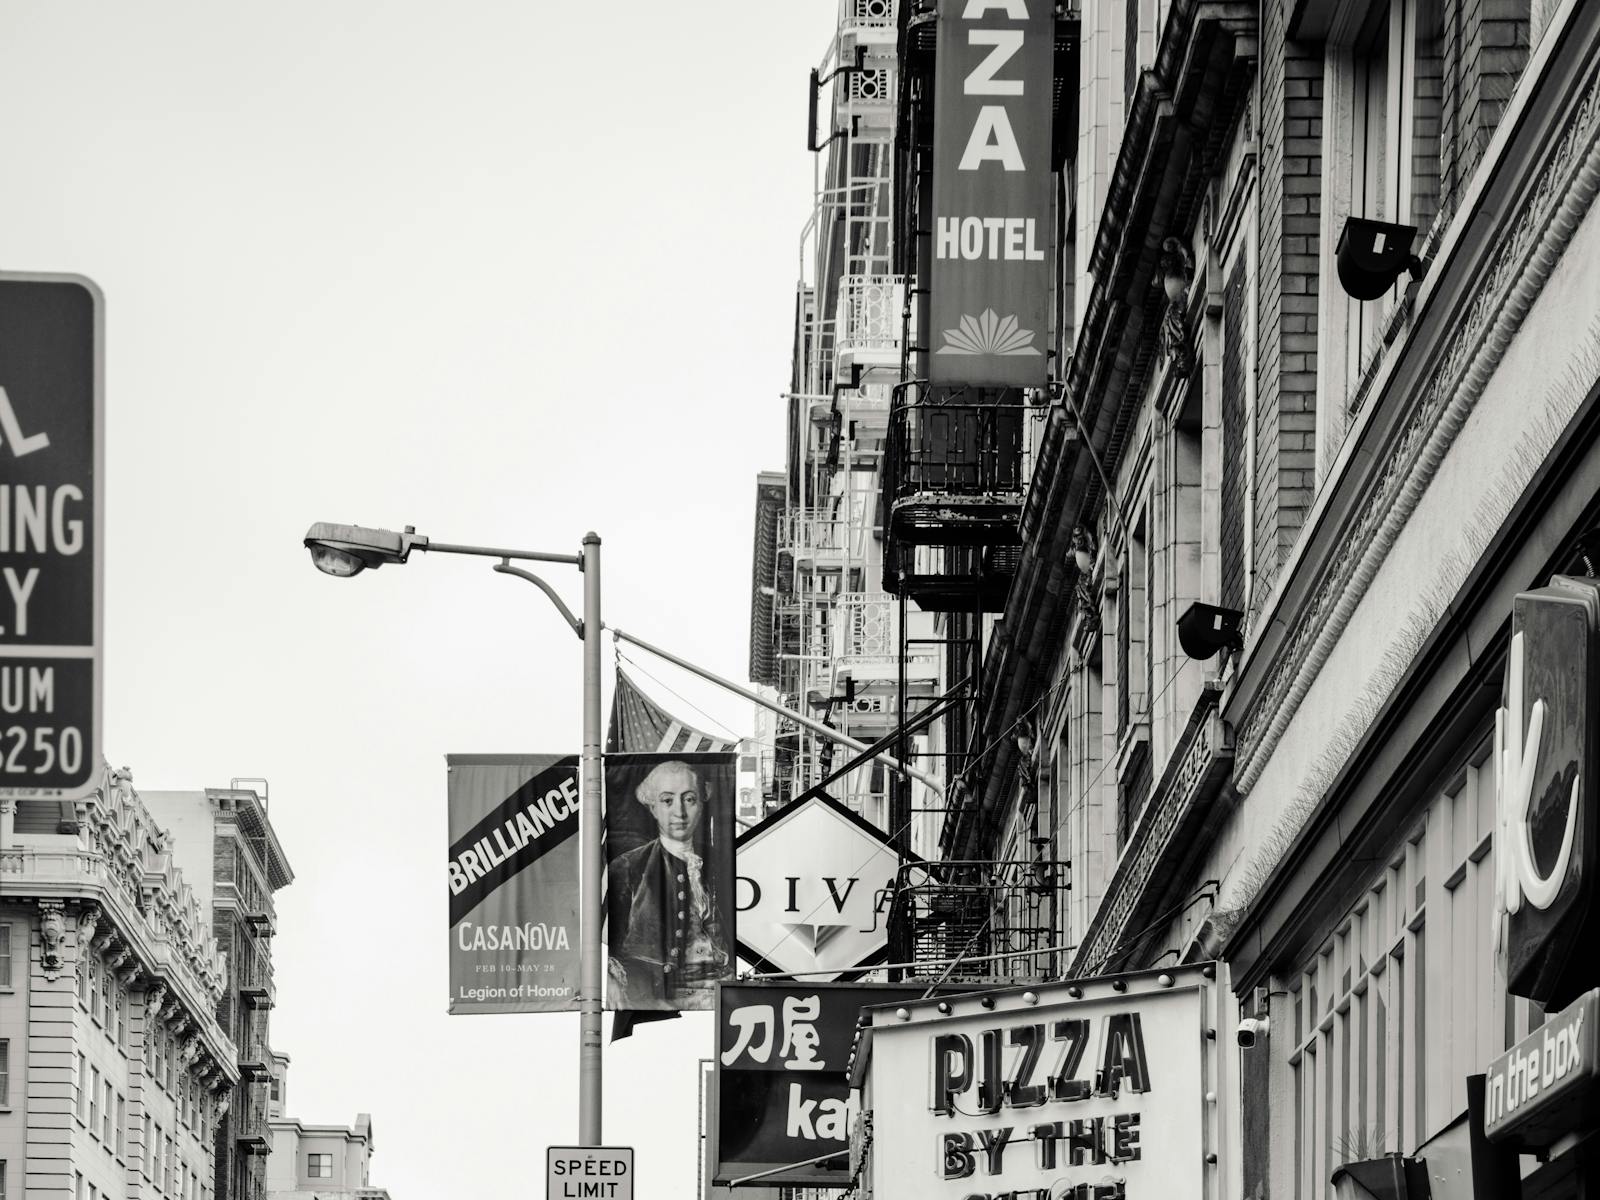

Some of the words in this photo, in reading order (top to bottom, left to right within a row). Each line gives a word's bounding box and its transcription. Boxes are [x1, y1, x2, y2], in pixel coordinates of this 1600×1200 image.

[936, 216, 1044, 261] HOTEL
[0, 726, 83, 775] 250
[448, 777, 580, 896] BRILLIANCE
[459, 921, 570, 952] CASANOVA
[460, 985, 507, 1000] Legion
[509, 984, 524, 998] of
[526, 984, 570, 998] Honor
[475, 964, 498, 973] FEB
[543, 964, 556, 973] 28
[721, 994, 826, 1071] 刀屋
[928, 1012, 1151, 1118] PIZZA
[1486, 1065, 1504, 1127] in
[1507, 1047, 1540, 1113] the
[1542, 1018, 1580, 1090] box
[554, 1160, 627, 1176] SPEED
[935, 1125, 1015, 1180] BY
[1028, 1112, 1142, 1170] THE
[563, 1183, 618, 1198] LIMIT
